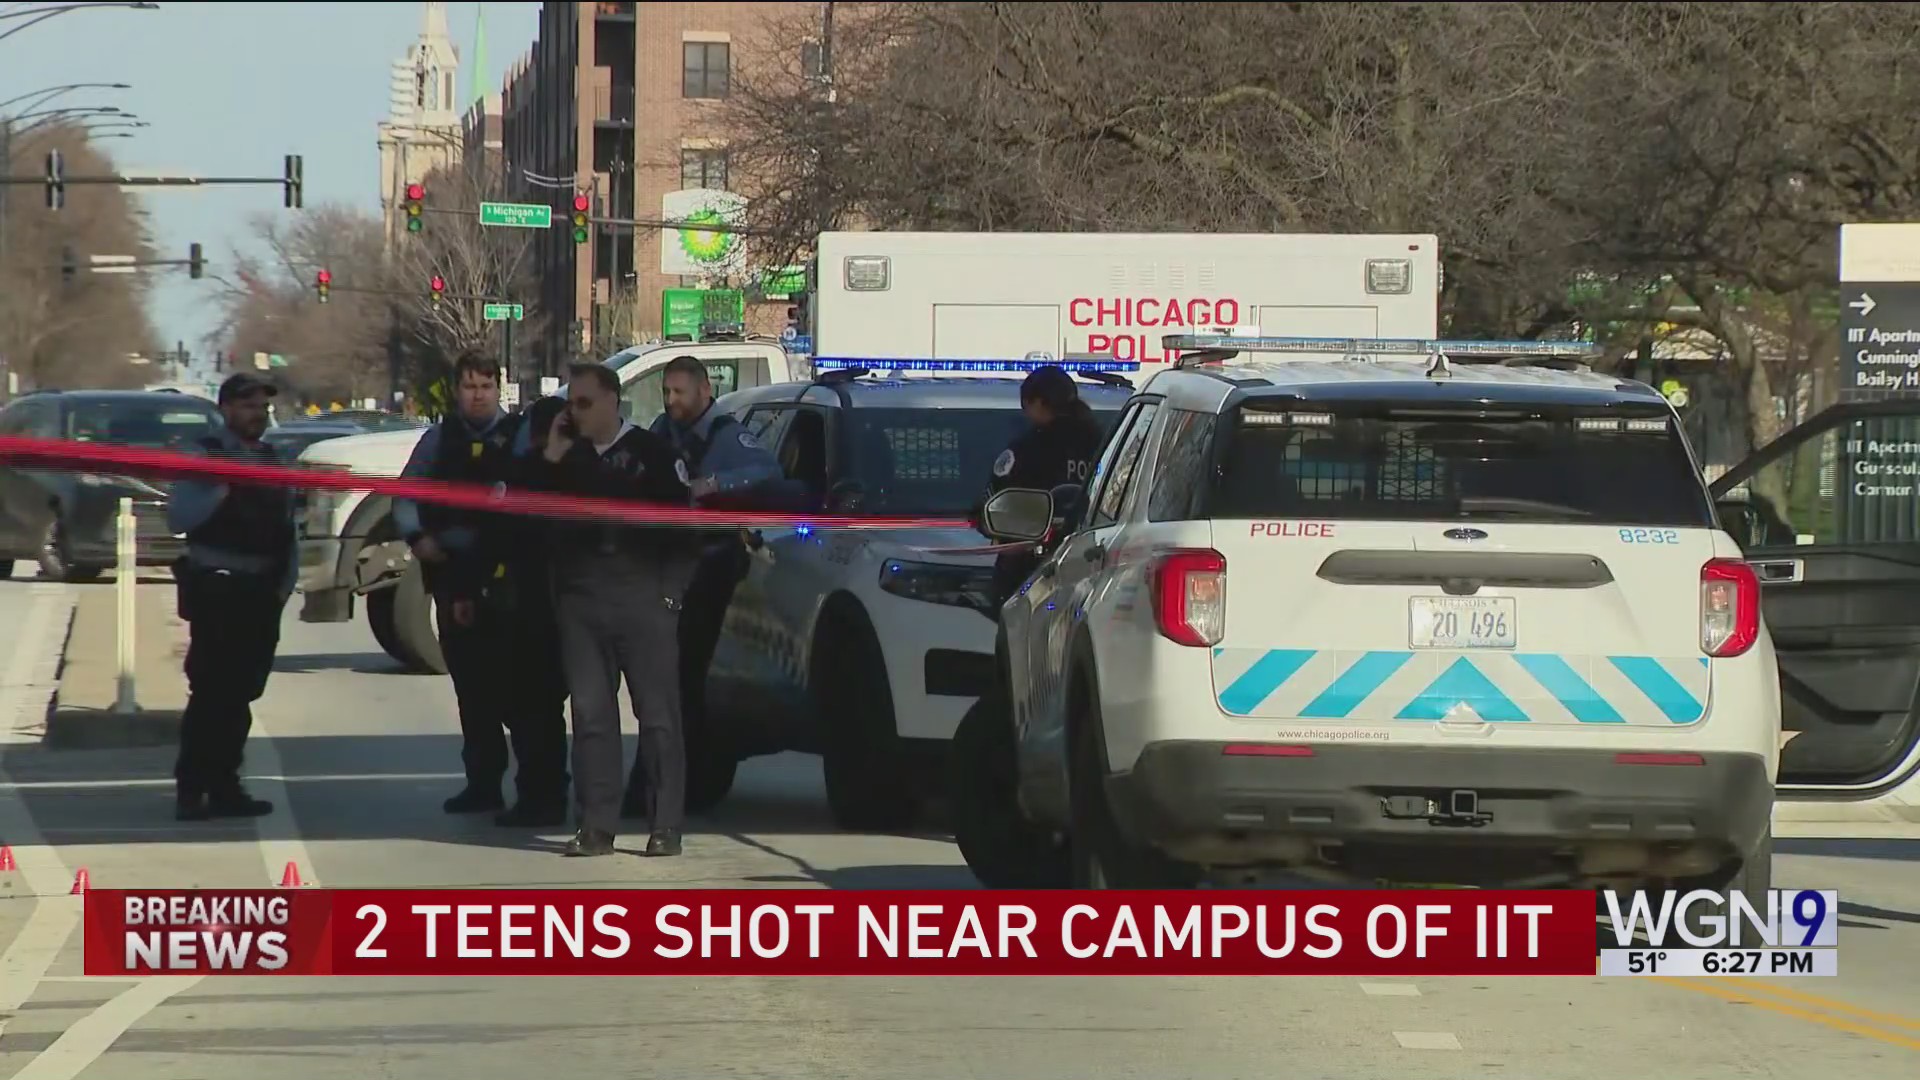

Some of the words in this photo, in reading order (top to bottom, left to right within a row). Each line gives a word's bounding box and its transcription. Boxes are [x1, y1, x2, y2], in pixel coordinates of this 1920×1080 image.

[493, 206, 534, 218] Michigan
[1070, 298, 1239, 327] CHICAGO
[1848, 328, 1866, 342] IIT
[1088, 334, 1186, 363] POLI
[1857, 349, 1920, 368] Cunning
[1857, 370, 1903, 390] Bailey
[1906, 371, 1919, 386] H
[1847, 440, 1863, 453] IIT
[1250, 522, 1336, 538] POLICE
[1618, 527, 1680, 544] 8232
[1433, 611, 1457, 638] 20
[1471, 611, 1506, 638] 496
[1277, 729, 1390, 740] www.chicagopolice.org
